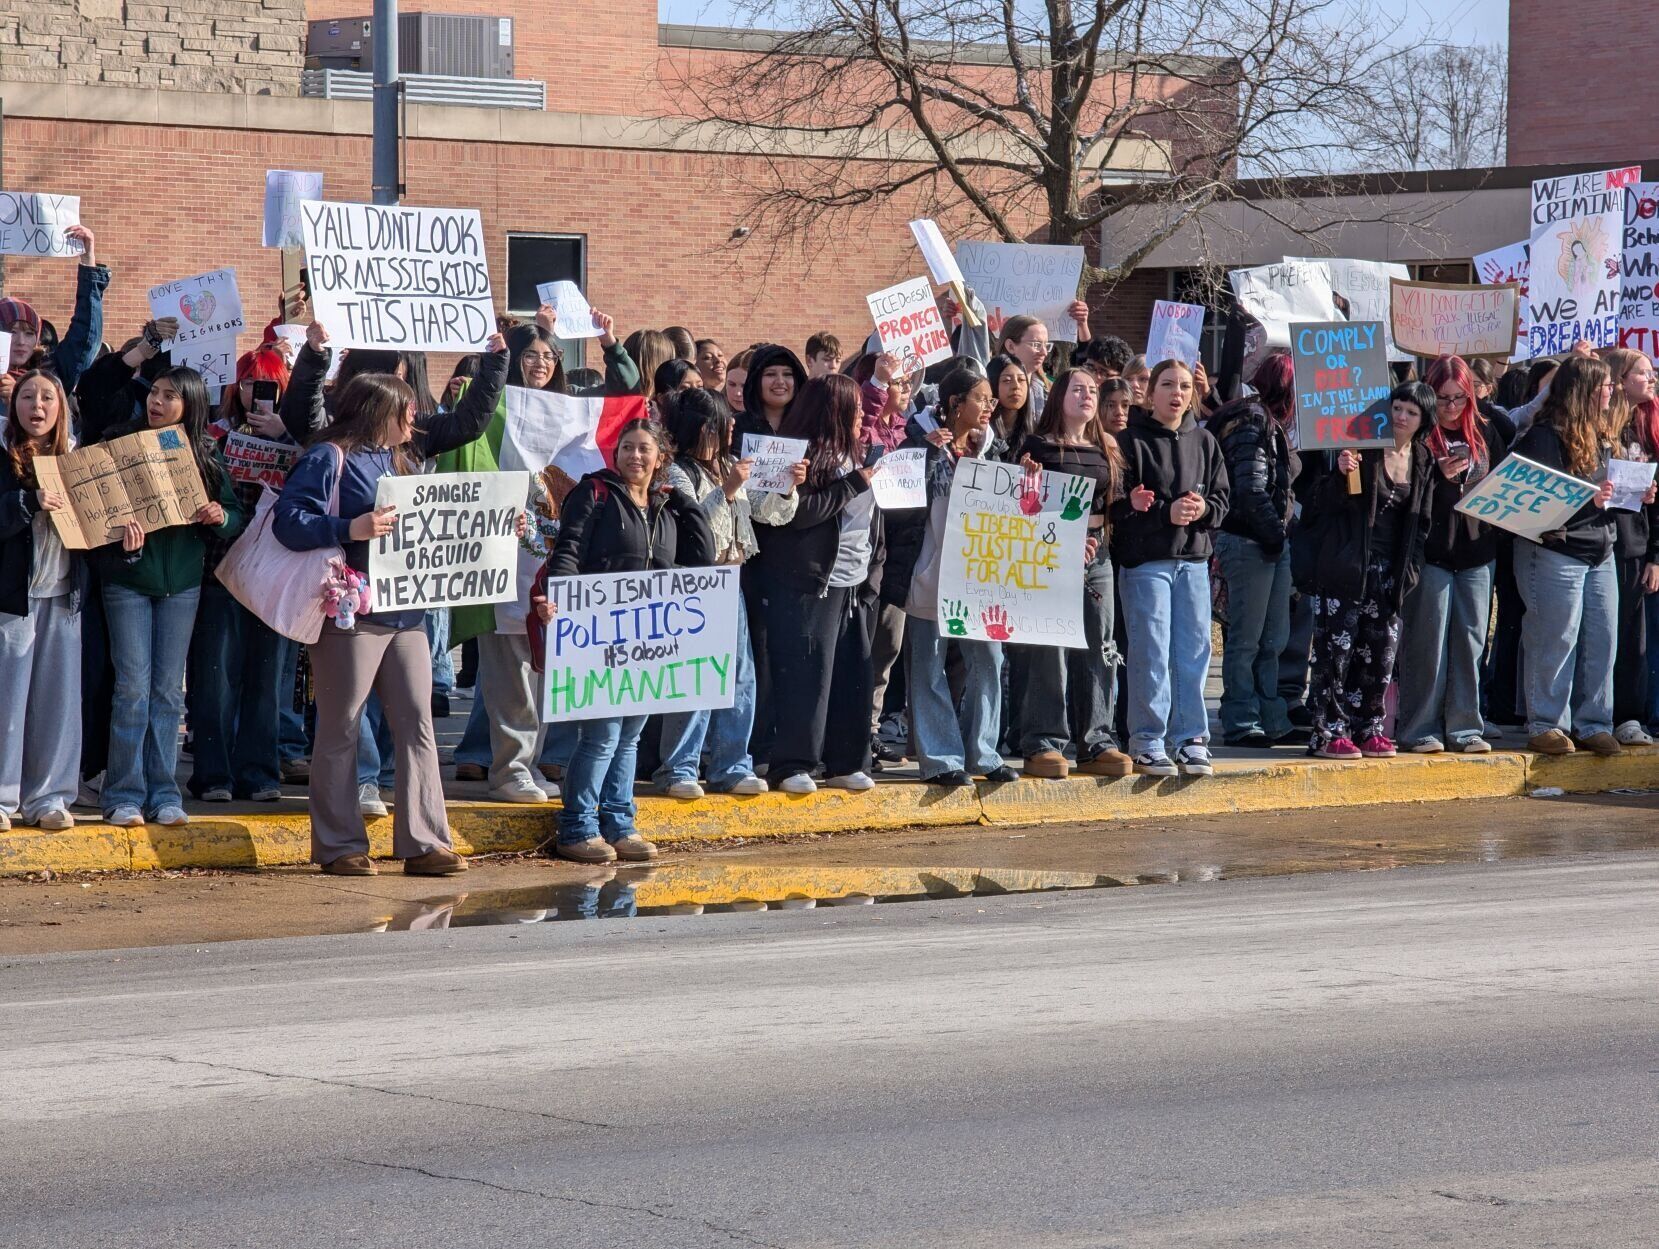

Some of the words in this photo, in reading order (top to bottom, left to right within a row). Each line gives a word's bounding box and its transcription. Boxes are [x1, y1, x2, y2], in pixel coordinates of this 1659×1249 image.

[1534, 179, 1567, 202] WE
[1573, 173, 1602, 196] ARE
[1605, 167, 1642, 190] NOT
[0, 193, 64, 226] ONLY
[416, 211, 477, 256] LOOK
[962, 244, 1000, 274] No
[1012, 249, 1056, 276] One
[151, 283, 183, 299] LOVE
[195, 273, 224, 287] THY
[311, 255, 352, 291] FOR
[355, 257, 440, 294] MISSIG
[440, 260, 489, 297] KIDS
[871, 292, 899, 318] ICE
[1530, 297, 1578, 323] We
[1594, 289, 1620, 315] Ar
[1620, 285, 1653, 302] AND
[337, 298, 406, 343] THIS
[410, 302, 487, 344] HARD
[879, 306, 940, 343] PROTECT
[1155, 303, 1200, 322] NOBODY
[1620, 303, 1645, 320] ARE
[1298, 324, 1377, 355] COMPLY
[1530, 315, 1620, 360] DREAME
[1326, 355, 1348, 369] OR
[1302, 392, 1322, 408] IN
[1326, 388, 1354, 405] THE
[1321, 404, 1336, 415] OF
[1341, 401, 1366, 415] THE
[226, 444, 276, 462] ILLEGALS
[231, 438, 244, 447] YOU
[246, 442, 264, 452] CALL
[962, 462, 987, 490] I
[1496, 460, 1598, 508] ABOLISH
[413, 482, 482, 507] SANGRE
[1465, 496, 1521, 521] FDT
[1492, 483, 1549, 514] ICE
[379, 507, 516, 554] MEXICANA
[962, 534, 1061, 568] JUSTICE
[966, 558, 1000, 584] FOR
[376, 568, 509, 607] MEXICANO
[631, 637, 679, 662] about
[551, 653, 731, 715] HUMANITY
